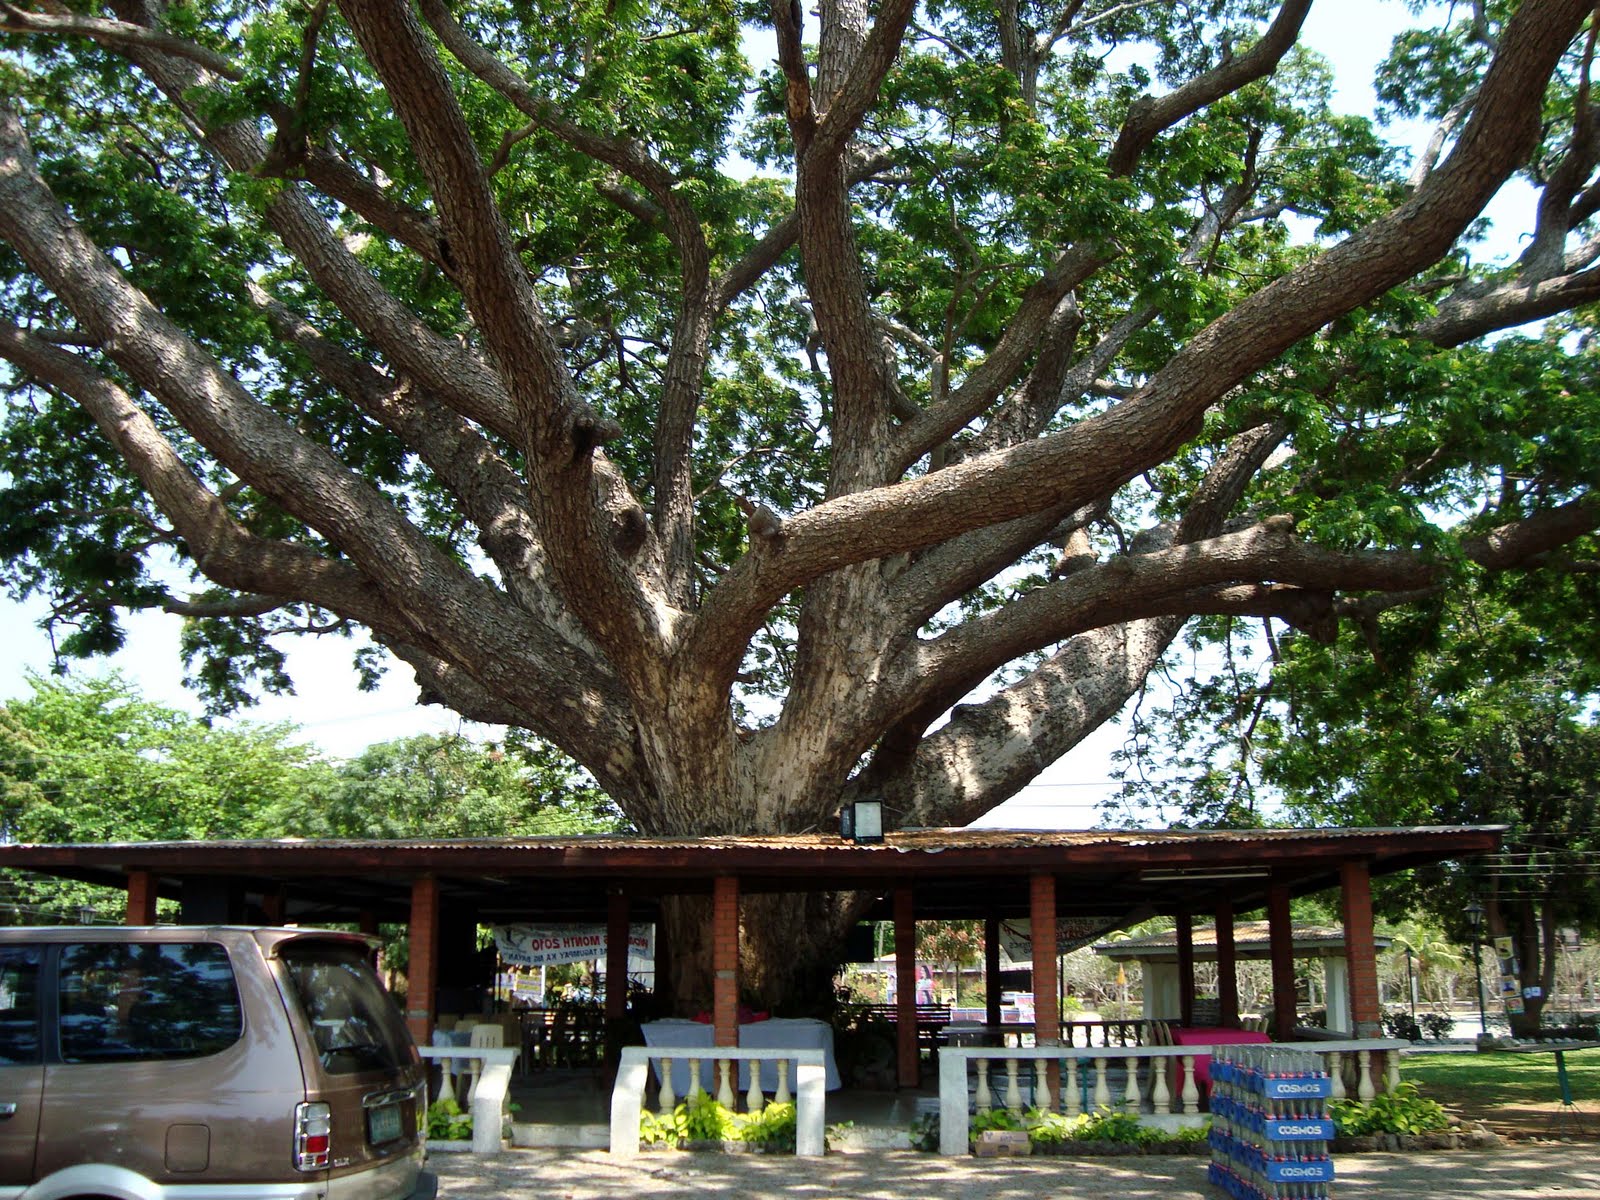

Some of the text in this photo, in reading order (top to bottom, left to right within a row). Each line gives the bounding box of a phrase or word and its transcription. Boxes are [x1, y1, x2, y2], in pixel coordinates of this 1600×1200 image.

[1277, 1084, 1321, 1094] COSMOS
[1278, 1125, 1322, 1135] COSMOS
[1280, 1167, 1323, 1177] COSMOS
